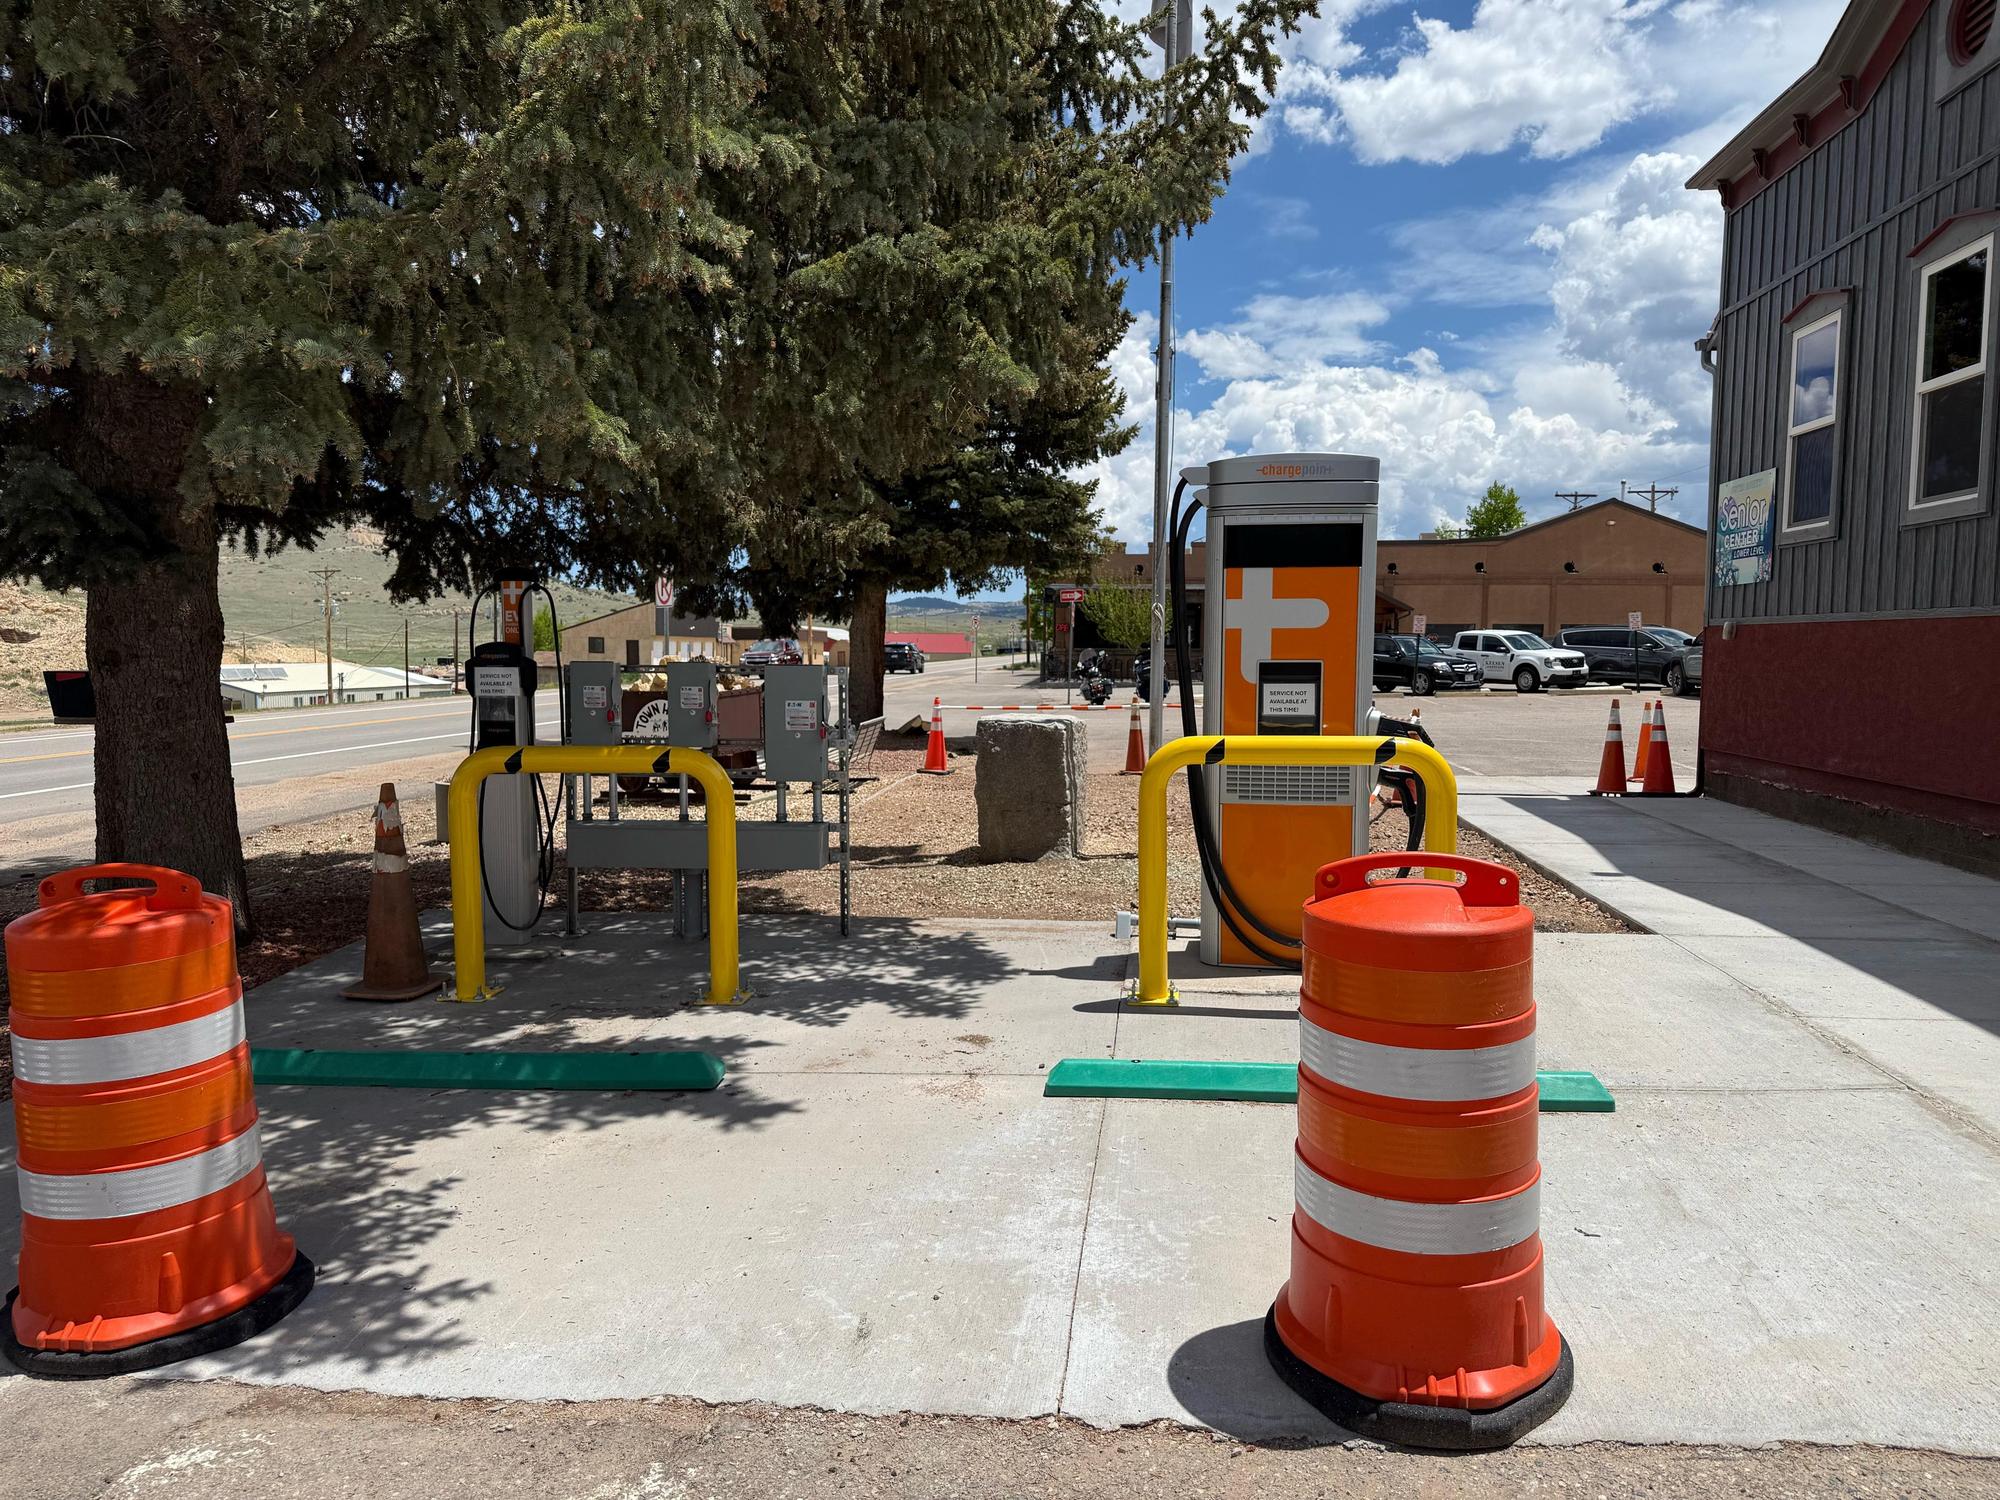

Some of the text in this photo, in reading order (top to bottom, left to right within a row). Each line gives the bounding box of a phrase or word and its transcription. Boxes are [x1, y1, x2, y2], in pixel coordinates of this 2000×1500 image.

[1721, 495, 1766, 531] Senior
[1724, 529, 1759, 550] CENTER
[1733, 546, 1765, 559] LOWER LEVEL
[636, 703, 661, 728] TOWN
